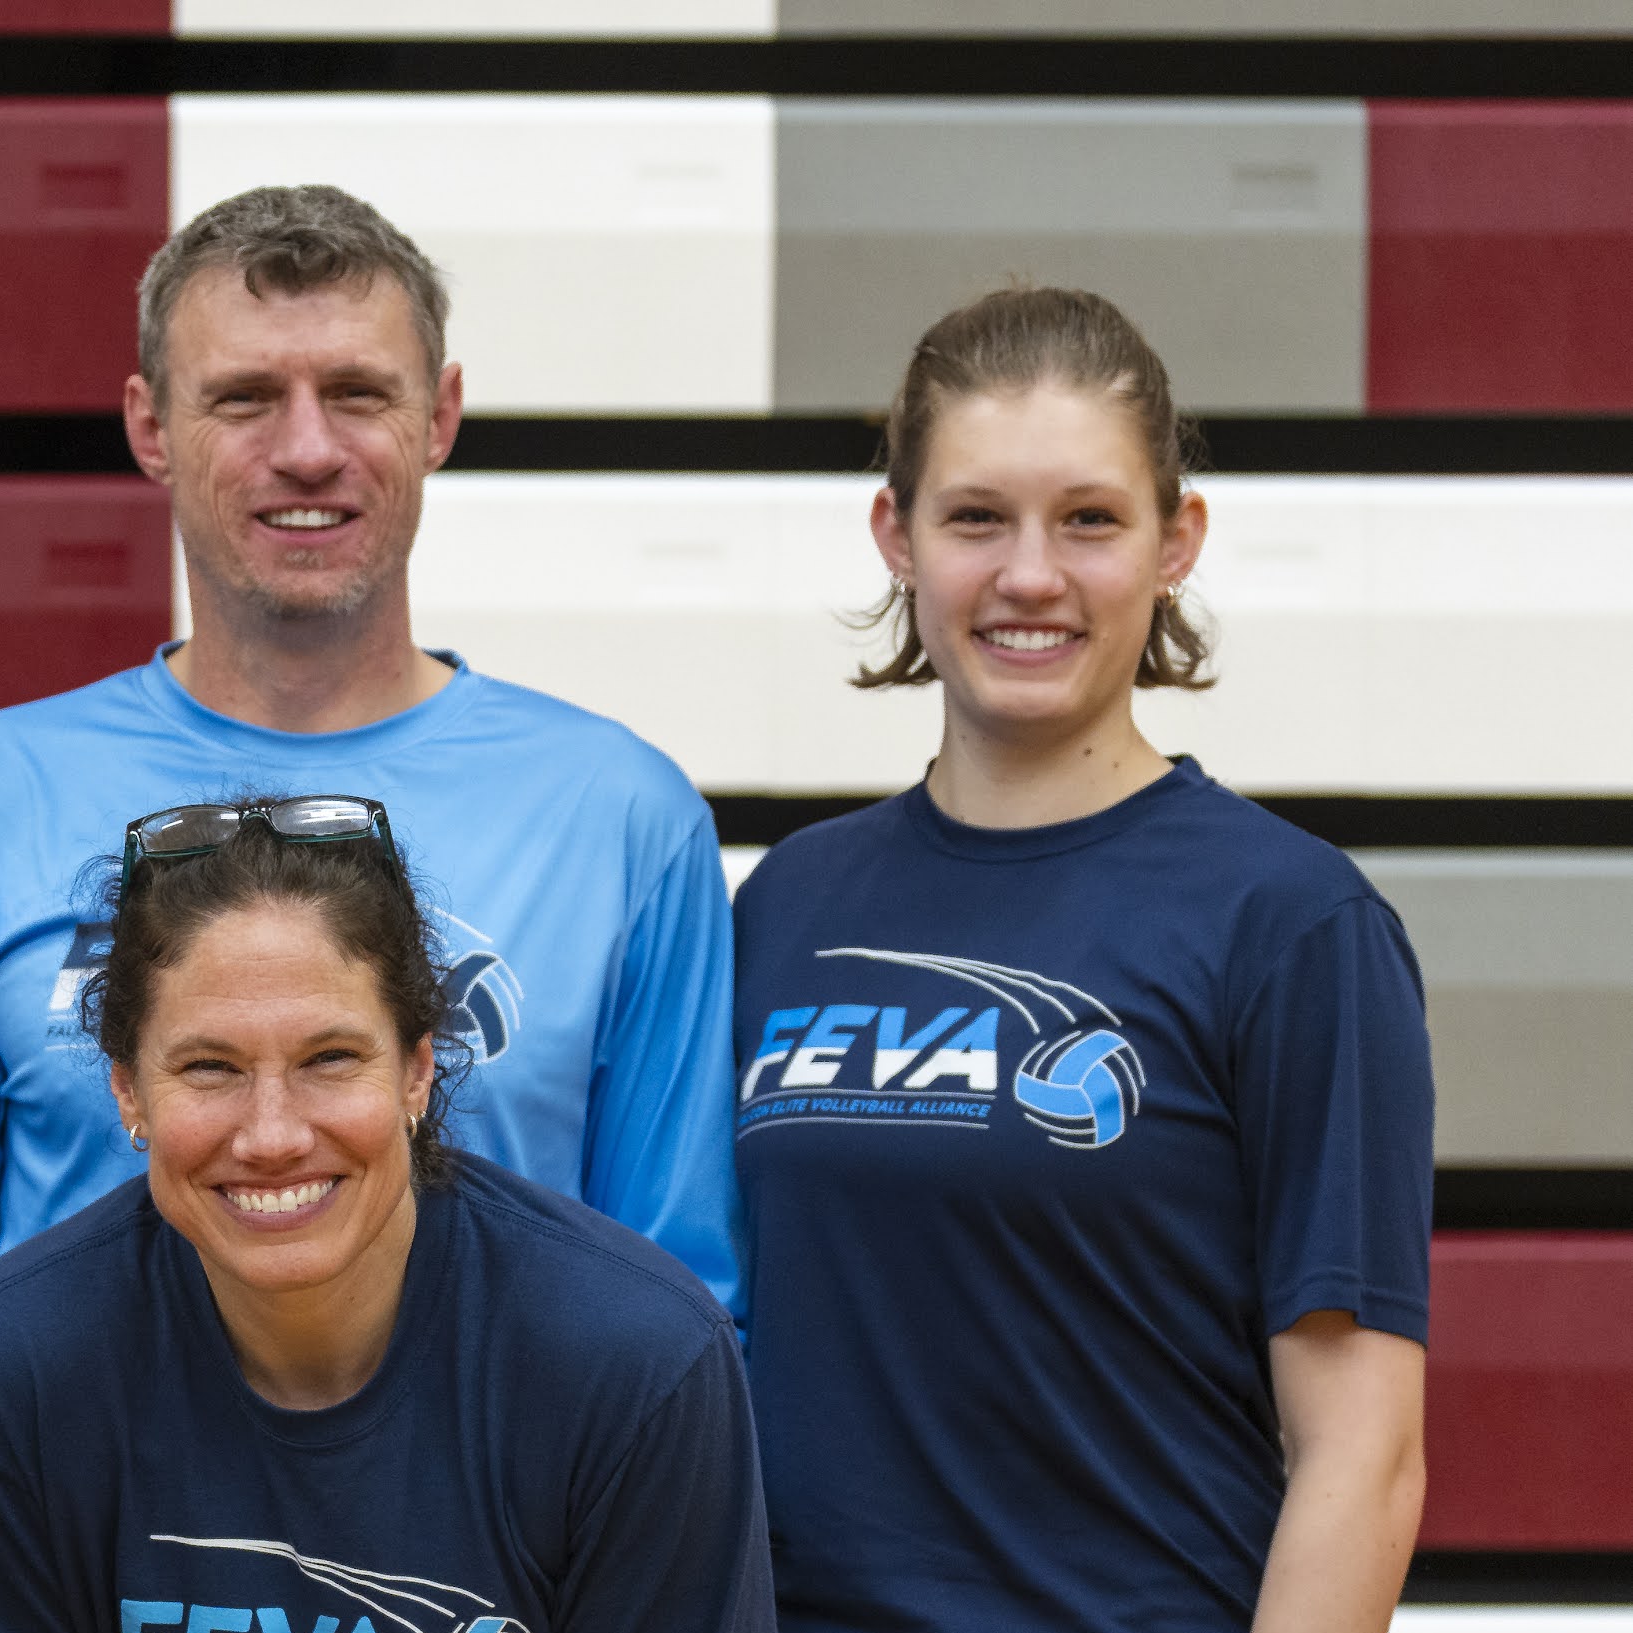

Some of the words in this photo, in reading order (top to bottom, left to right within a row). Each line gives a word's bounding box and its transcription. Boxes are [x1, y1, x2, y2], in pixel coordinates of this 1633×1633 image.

[739, 1004, 1001, 1102] FEVA
[810, 1097, 905, 1115] VOLLEYBALL
[908, 1101, 992, 1119] ALLIANCE
